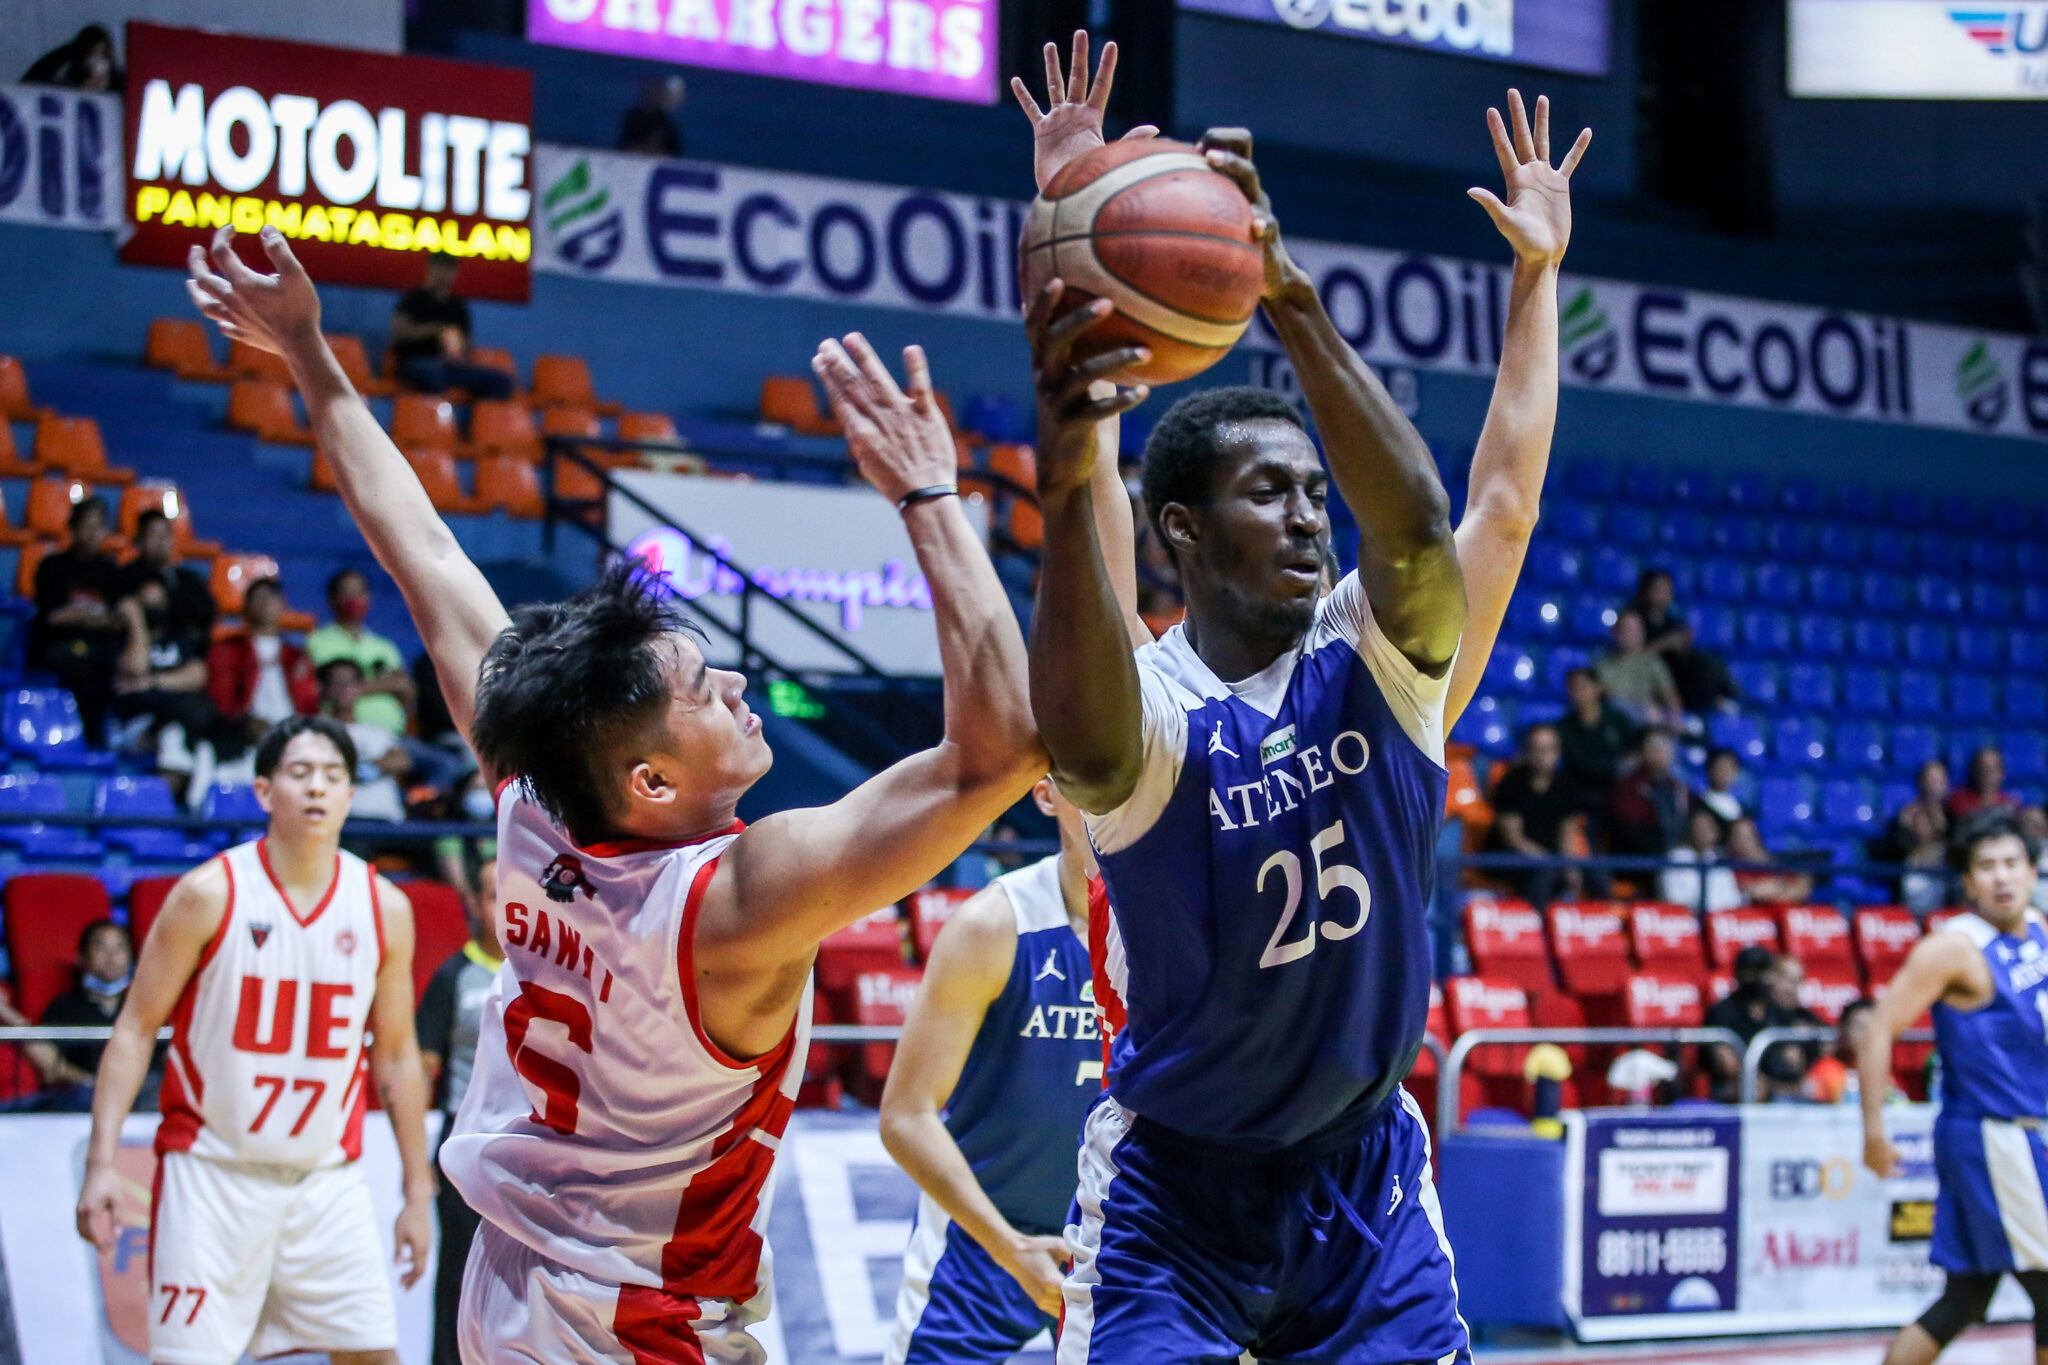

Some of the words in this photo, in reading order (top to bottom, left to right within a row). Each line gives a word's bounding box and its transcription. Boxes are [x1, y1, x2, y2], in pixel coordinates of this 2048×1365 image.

[133, 78, 531, 222] MOTOLITE
[644, 165, 1026, 314] EcoOil
[1632, 288, 1916, 417] EcoOil
[1208, 730, 1371, 832] ATENEO
[1256, 818, 1373, 969] 25
[232, 974, 355, 1060] UE
[1019, 1004, 1104, 1041] ATE
[247, 1075, 327, 1138] 77
[160, 1284, 206, 1326] 77
